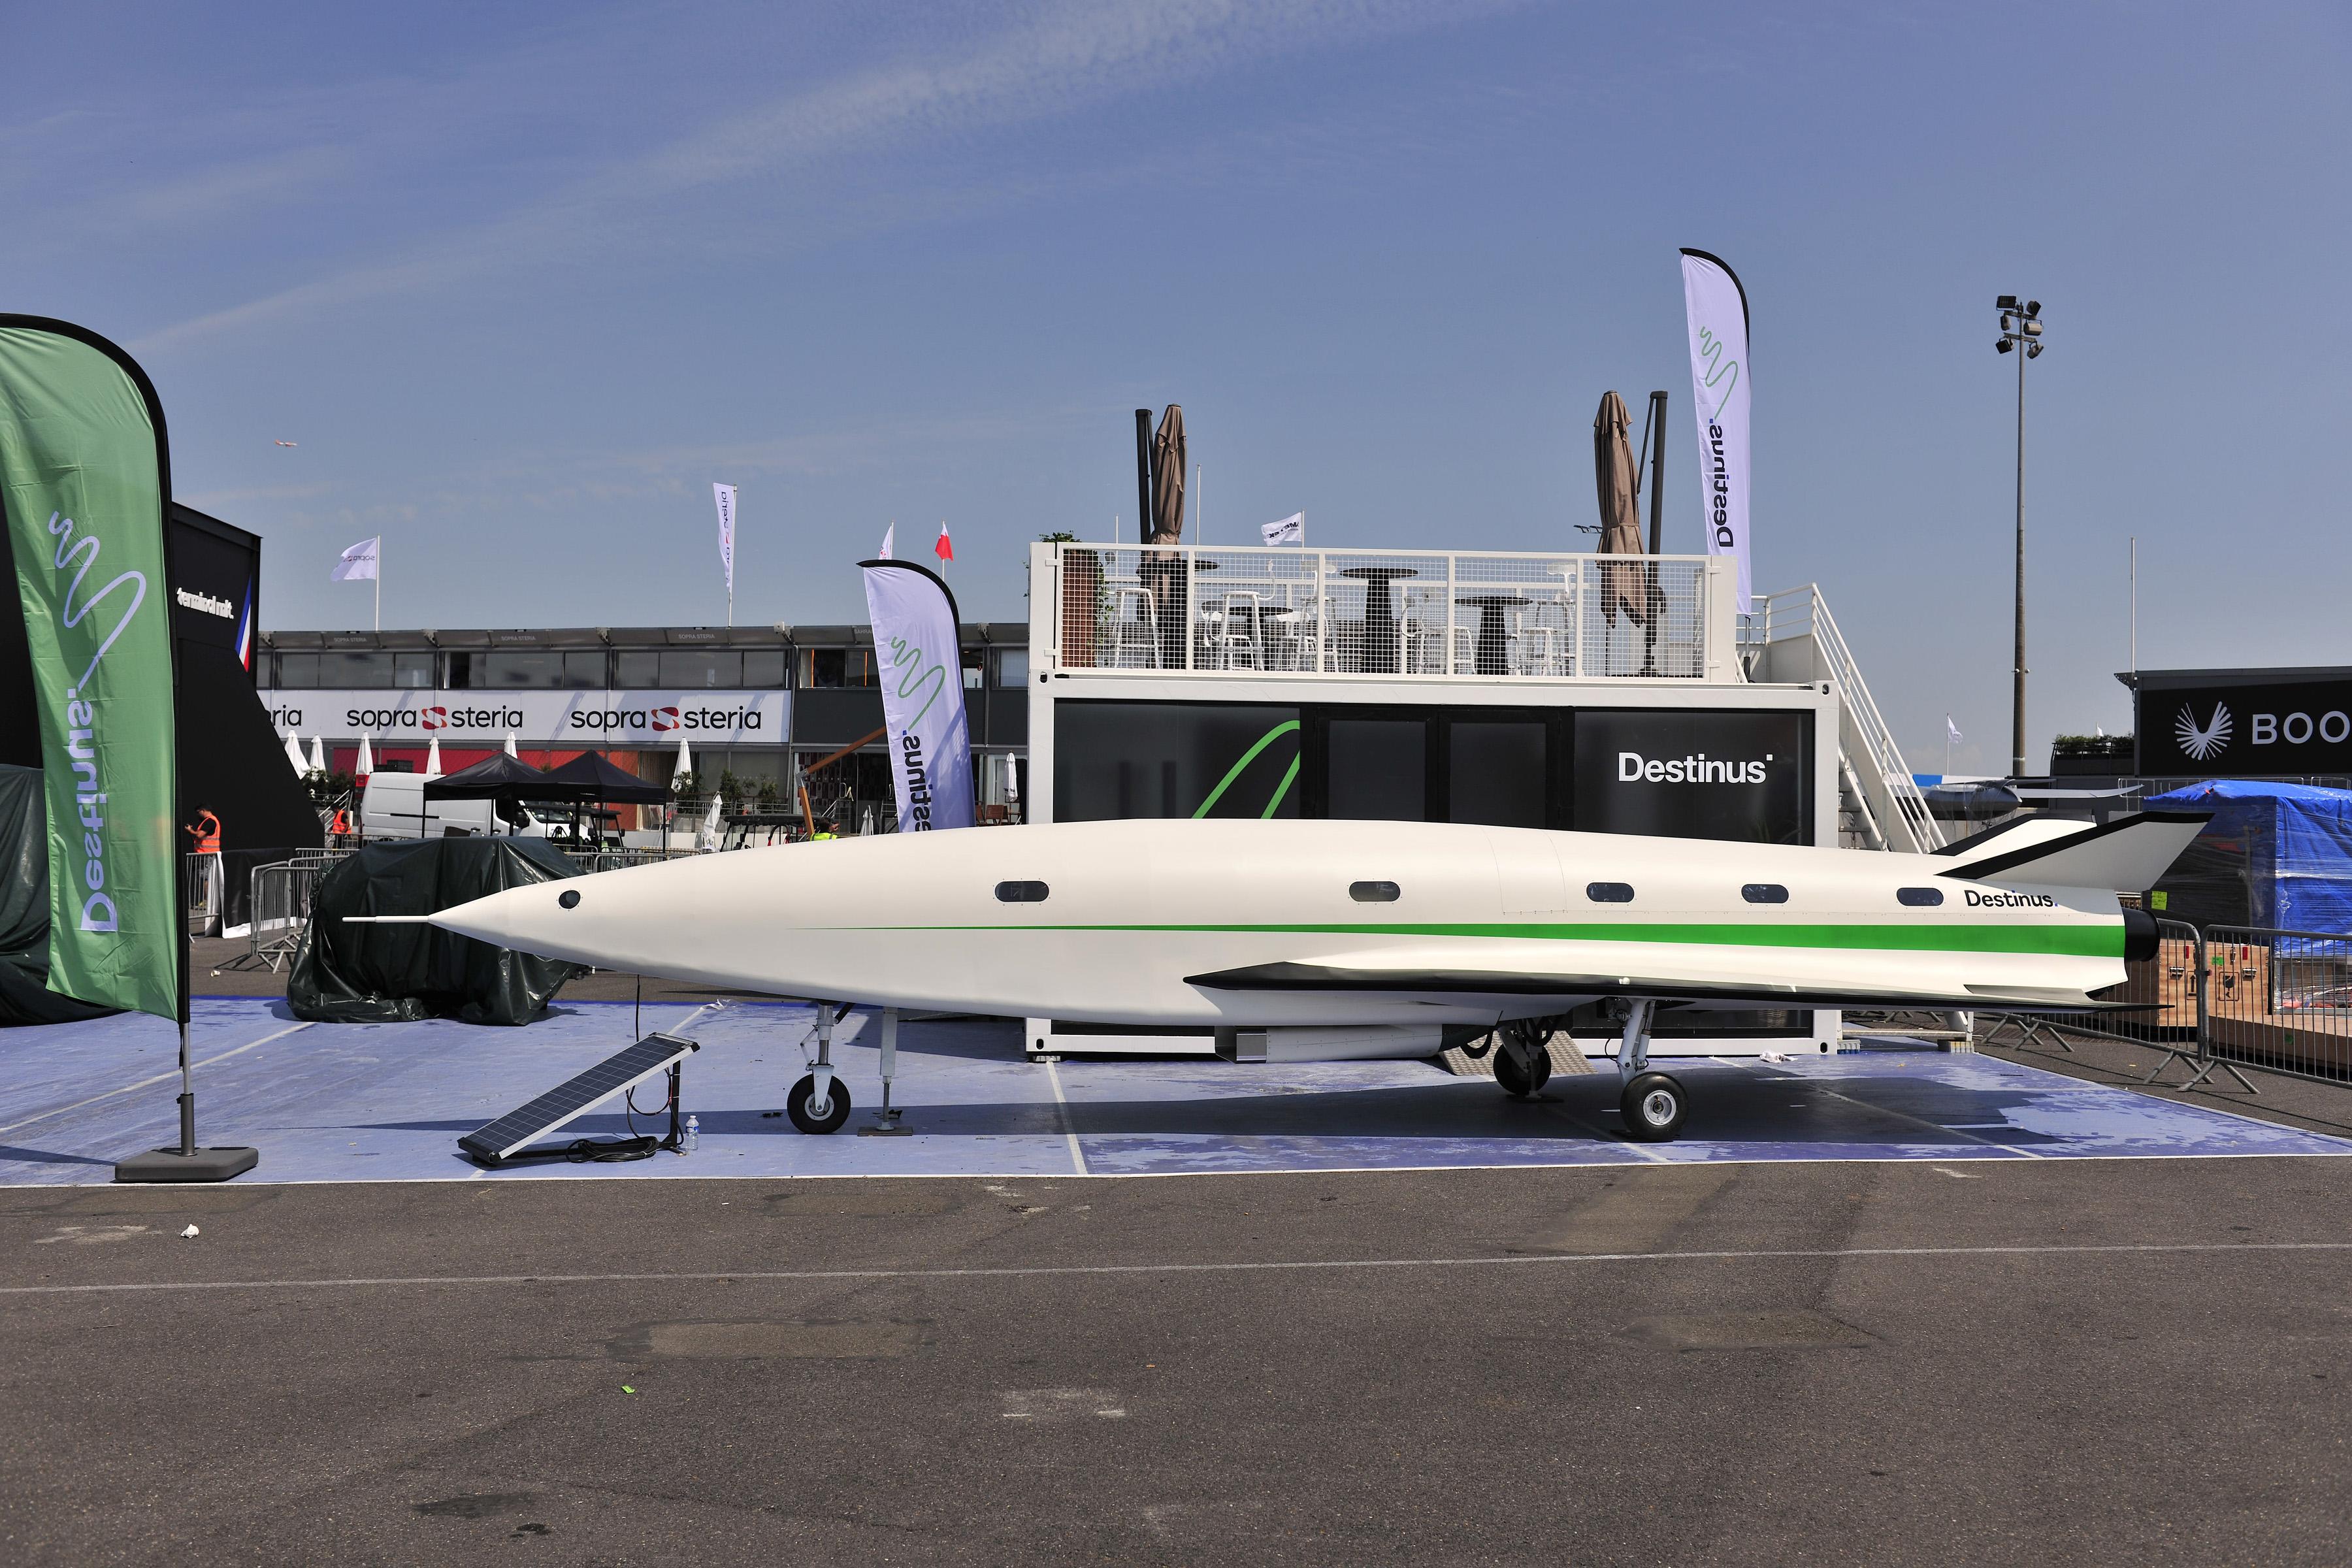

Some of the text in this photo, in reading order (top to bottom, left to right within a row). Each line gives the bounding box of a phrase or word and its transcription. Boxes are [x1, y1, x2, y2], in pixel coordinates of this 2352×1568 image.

[265, 704, 302, 727] ria
[347, 705, 523, 730] sopra steria
[570, 706, 761, 732] sopra steria
[2252, 710, 2351, 745] BOO
[1964, 890, 2059, 907] Destinus.
